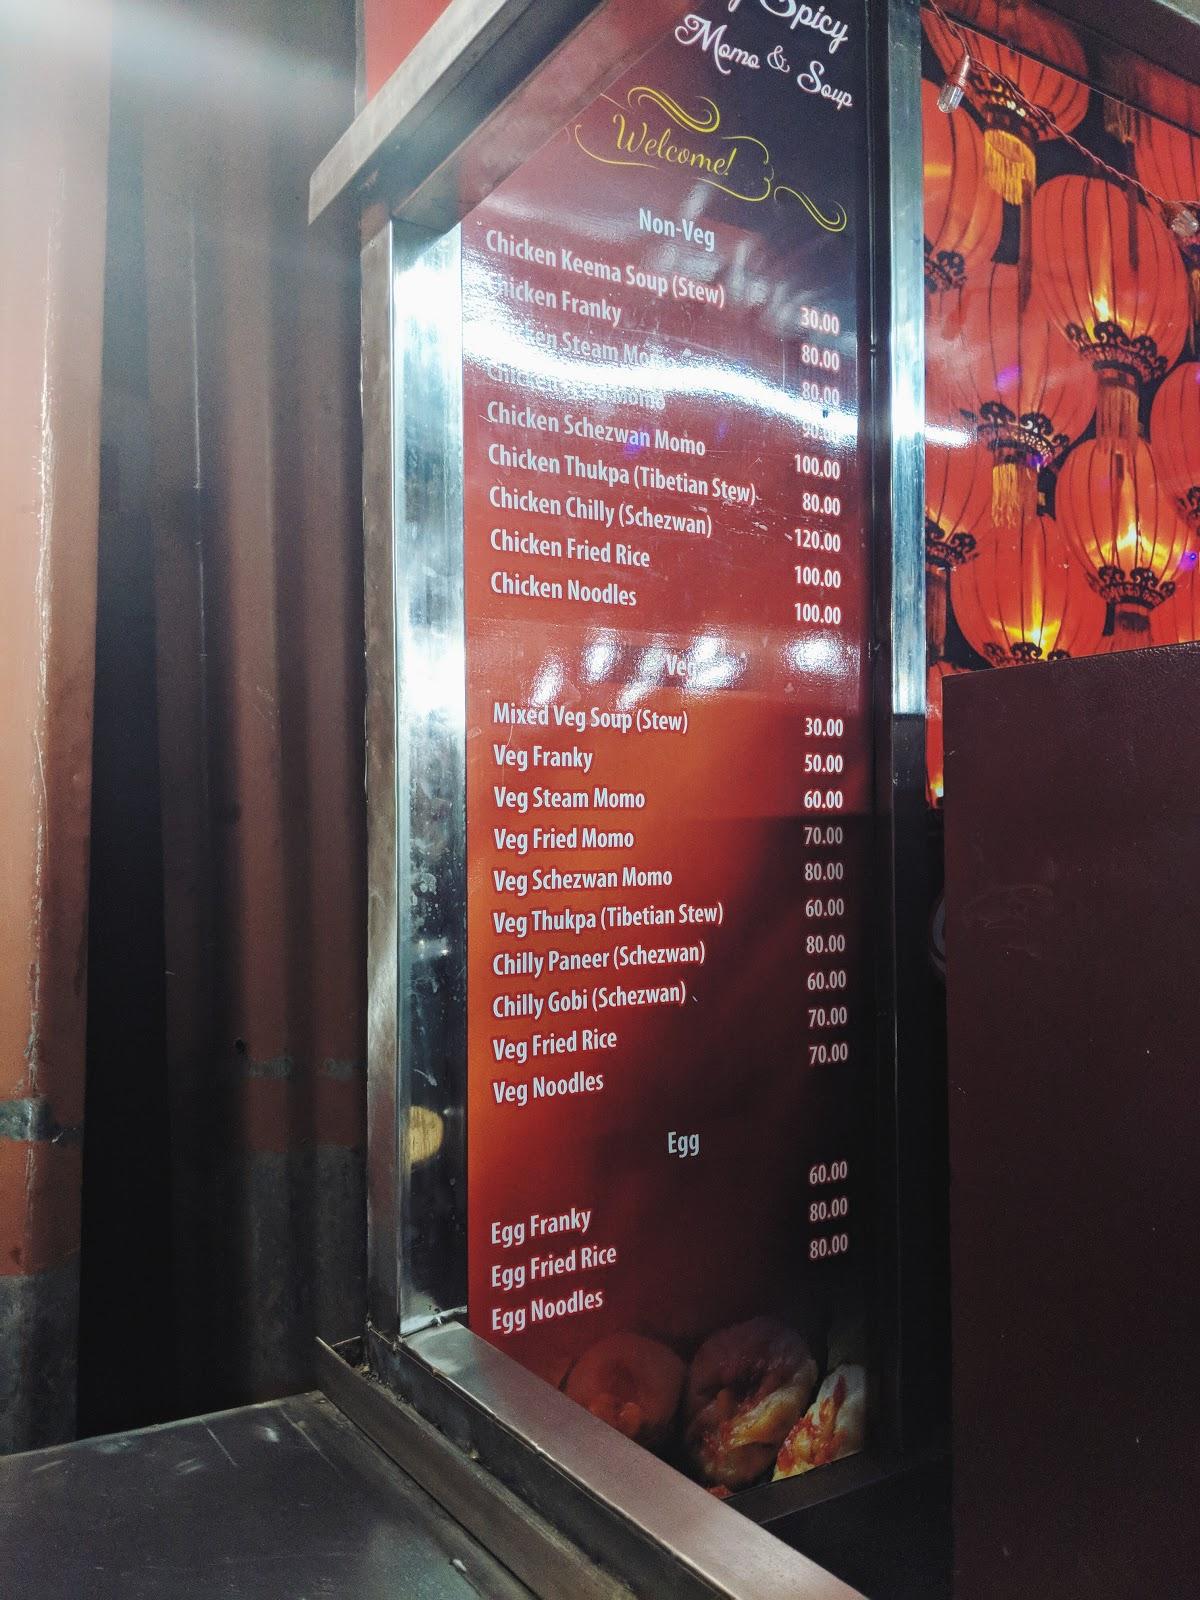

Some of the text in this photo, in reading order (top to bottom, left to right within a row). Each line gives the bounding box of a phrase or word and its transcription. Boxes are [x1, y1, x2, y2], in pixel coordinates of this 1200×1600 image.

[675, 14, 852, 110] Momo & Soup
[613, 114, 737, 176] Welcome!
[639, 208, 715, 253] Non-Veg
[486, 230, 725, 309] Chicken Keema Soup (Stew)
[562, 290, 622, 328] Franky
[801, 307, 839, 335] 30.00
[562, 331, 619, 364] Steam
[801, 344, 839, 371] 80.00
[802, 381, 840, 407] 80.00
[487, 401, 706, 456] Chicken Schezwan Momo
[488, 443, 756, 505] Chicken Thukpa (Tibetian Stew)
[794, 454, 841, 479] 100.00
[489, 485, 712, 538] Chicken Chilly (Schezwan)
[802, 492, 841, 516] 80.00
[490, 528, 650, 567] Chicken Fried Rice
[795, 528, 841, 552] 120.00
[491, 571, 636, 606] Chicken Noodles
[795, 565, 841, 588] 100.00
[795, 602, 841, 625] 100.00
[493, 702, 688, 734] Mixed Veg Soup (Stew)
[804, 717, 843, 737] 30.00
[494, 744, 593, 773] Veg Franky
[804, 754, 843, 773] 50.00
[494, 786, 645, 813] Veg Steam Momo
[804, 790, 843, 809] 60.00
[494, 828, 634, 855] Veg Fried Momo
[804, 826, 843, 845] 70.00
[493, 867, 673, 896] Veg Schezwan Momo
[804, 862, 844, 881] 80.00
[493, 902, 724, 938] Veg Thukpa (Tibetian Stew)
[805, 898, 844, 917] 60.00
[806, 934, 846, 954] 80.00
[493, 940, 706, 979] Chilly Paneer (Schezwan)
[807, 970, 847, 990] 60.00
[493, 980, 686, 1020] Chilly Gobi (Schezwan)
[808, 1006, 847, 1027] 70.00
[493, 1028, 617, 1064] Veg Fried Rice
[809, 1043, 848, 1065] 70.00
[493, 1070, 604, 1107] Veg Noodles
[667, 1131, 700, 1158] Egg
[809, 1161, 848, 1185] 60.00
[809, 1197, 848, 1222] 80.00
[491, 1207, 591, 1248] Egg Franky
[810, 1233, 848, 1259] 80.00
[491, 1245, 617, 1291] Egg Fried Rice
[492, 1289, 603, 1334] Egg Noodles
